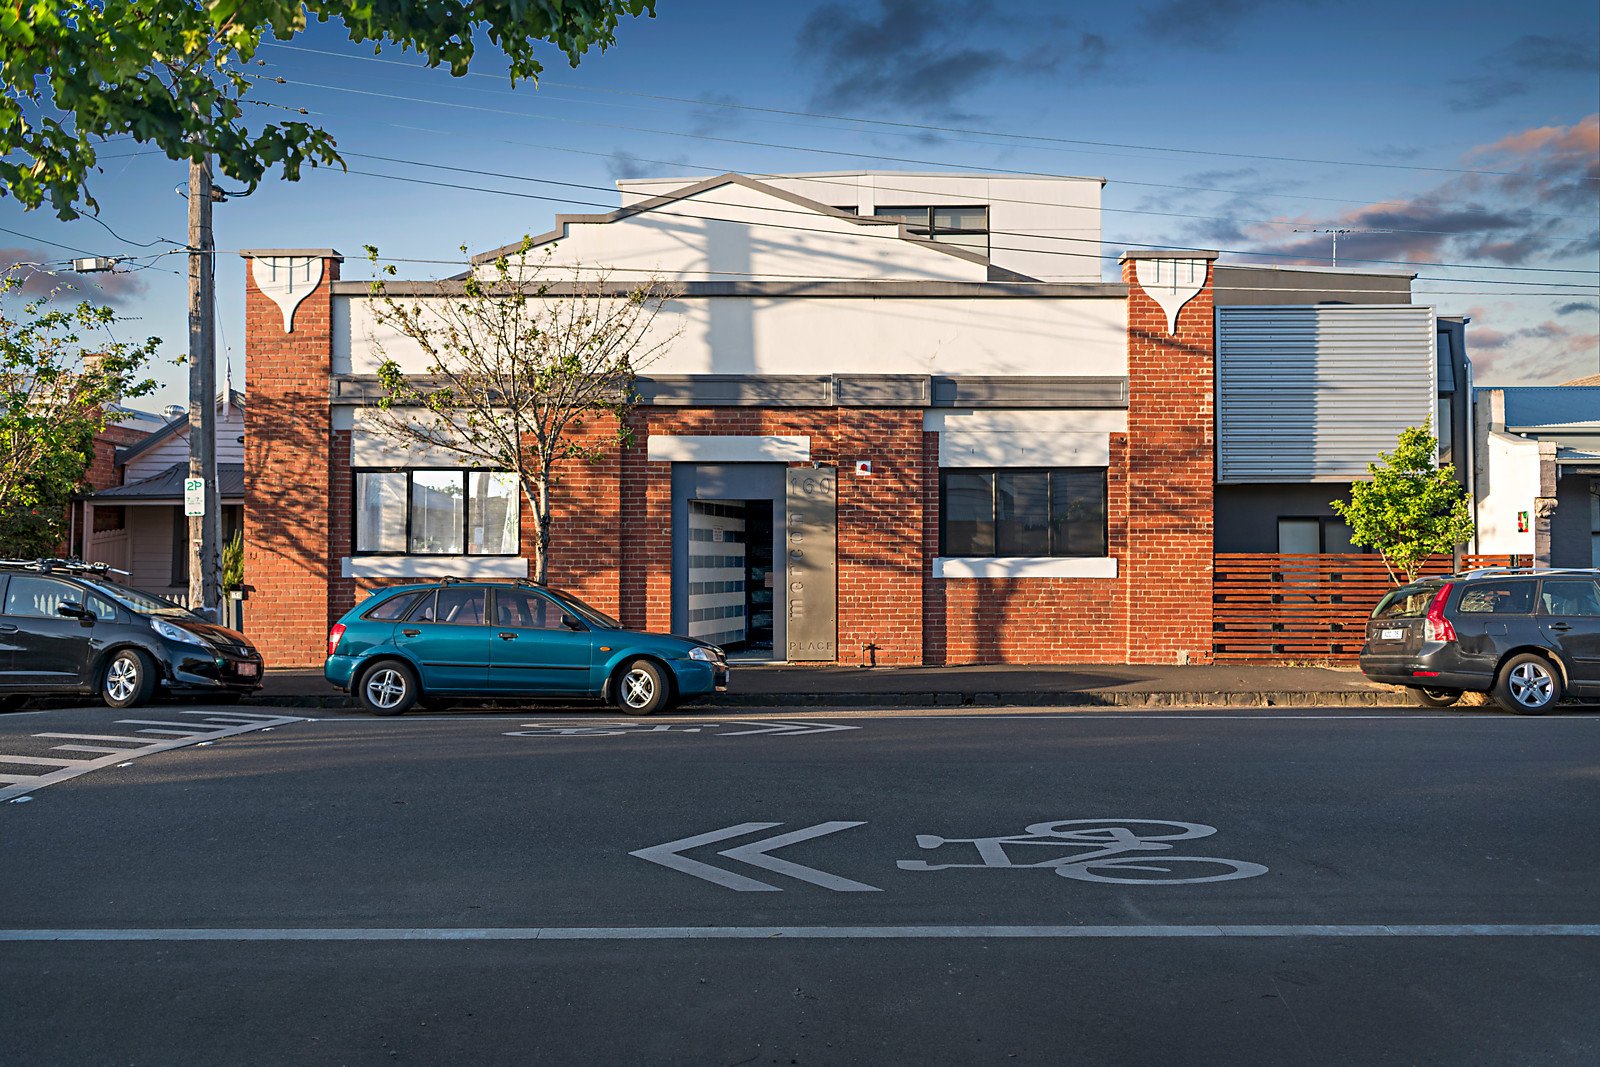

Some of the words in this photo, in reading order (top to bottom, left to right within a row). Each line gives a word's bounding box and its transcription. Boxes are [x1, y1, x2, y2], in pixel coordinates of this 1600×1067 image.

[187, 481, 202, 491] 2P
[790, 477, 831, 495] 160
[789, 513, 804, 618] mercon
[789, 641, 833, 650] PLACE
